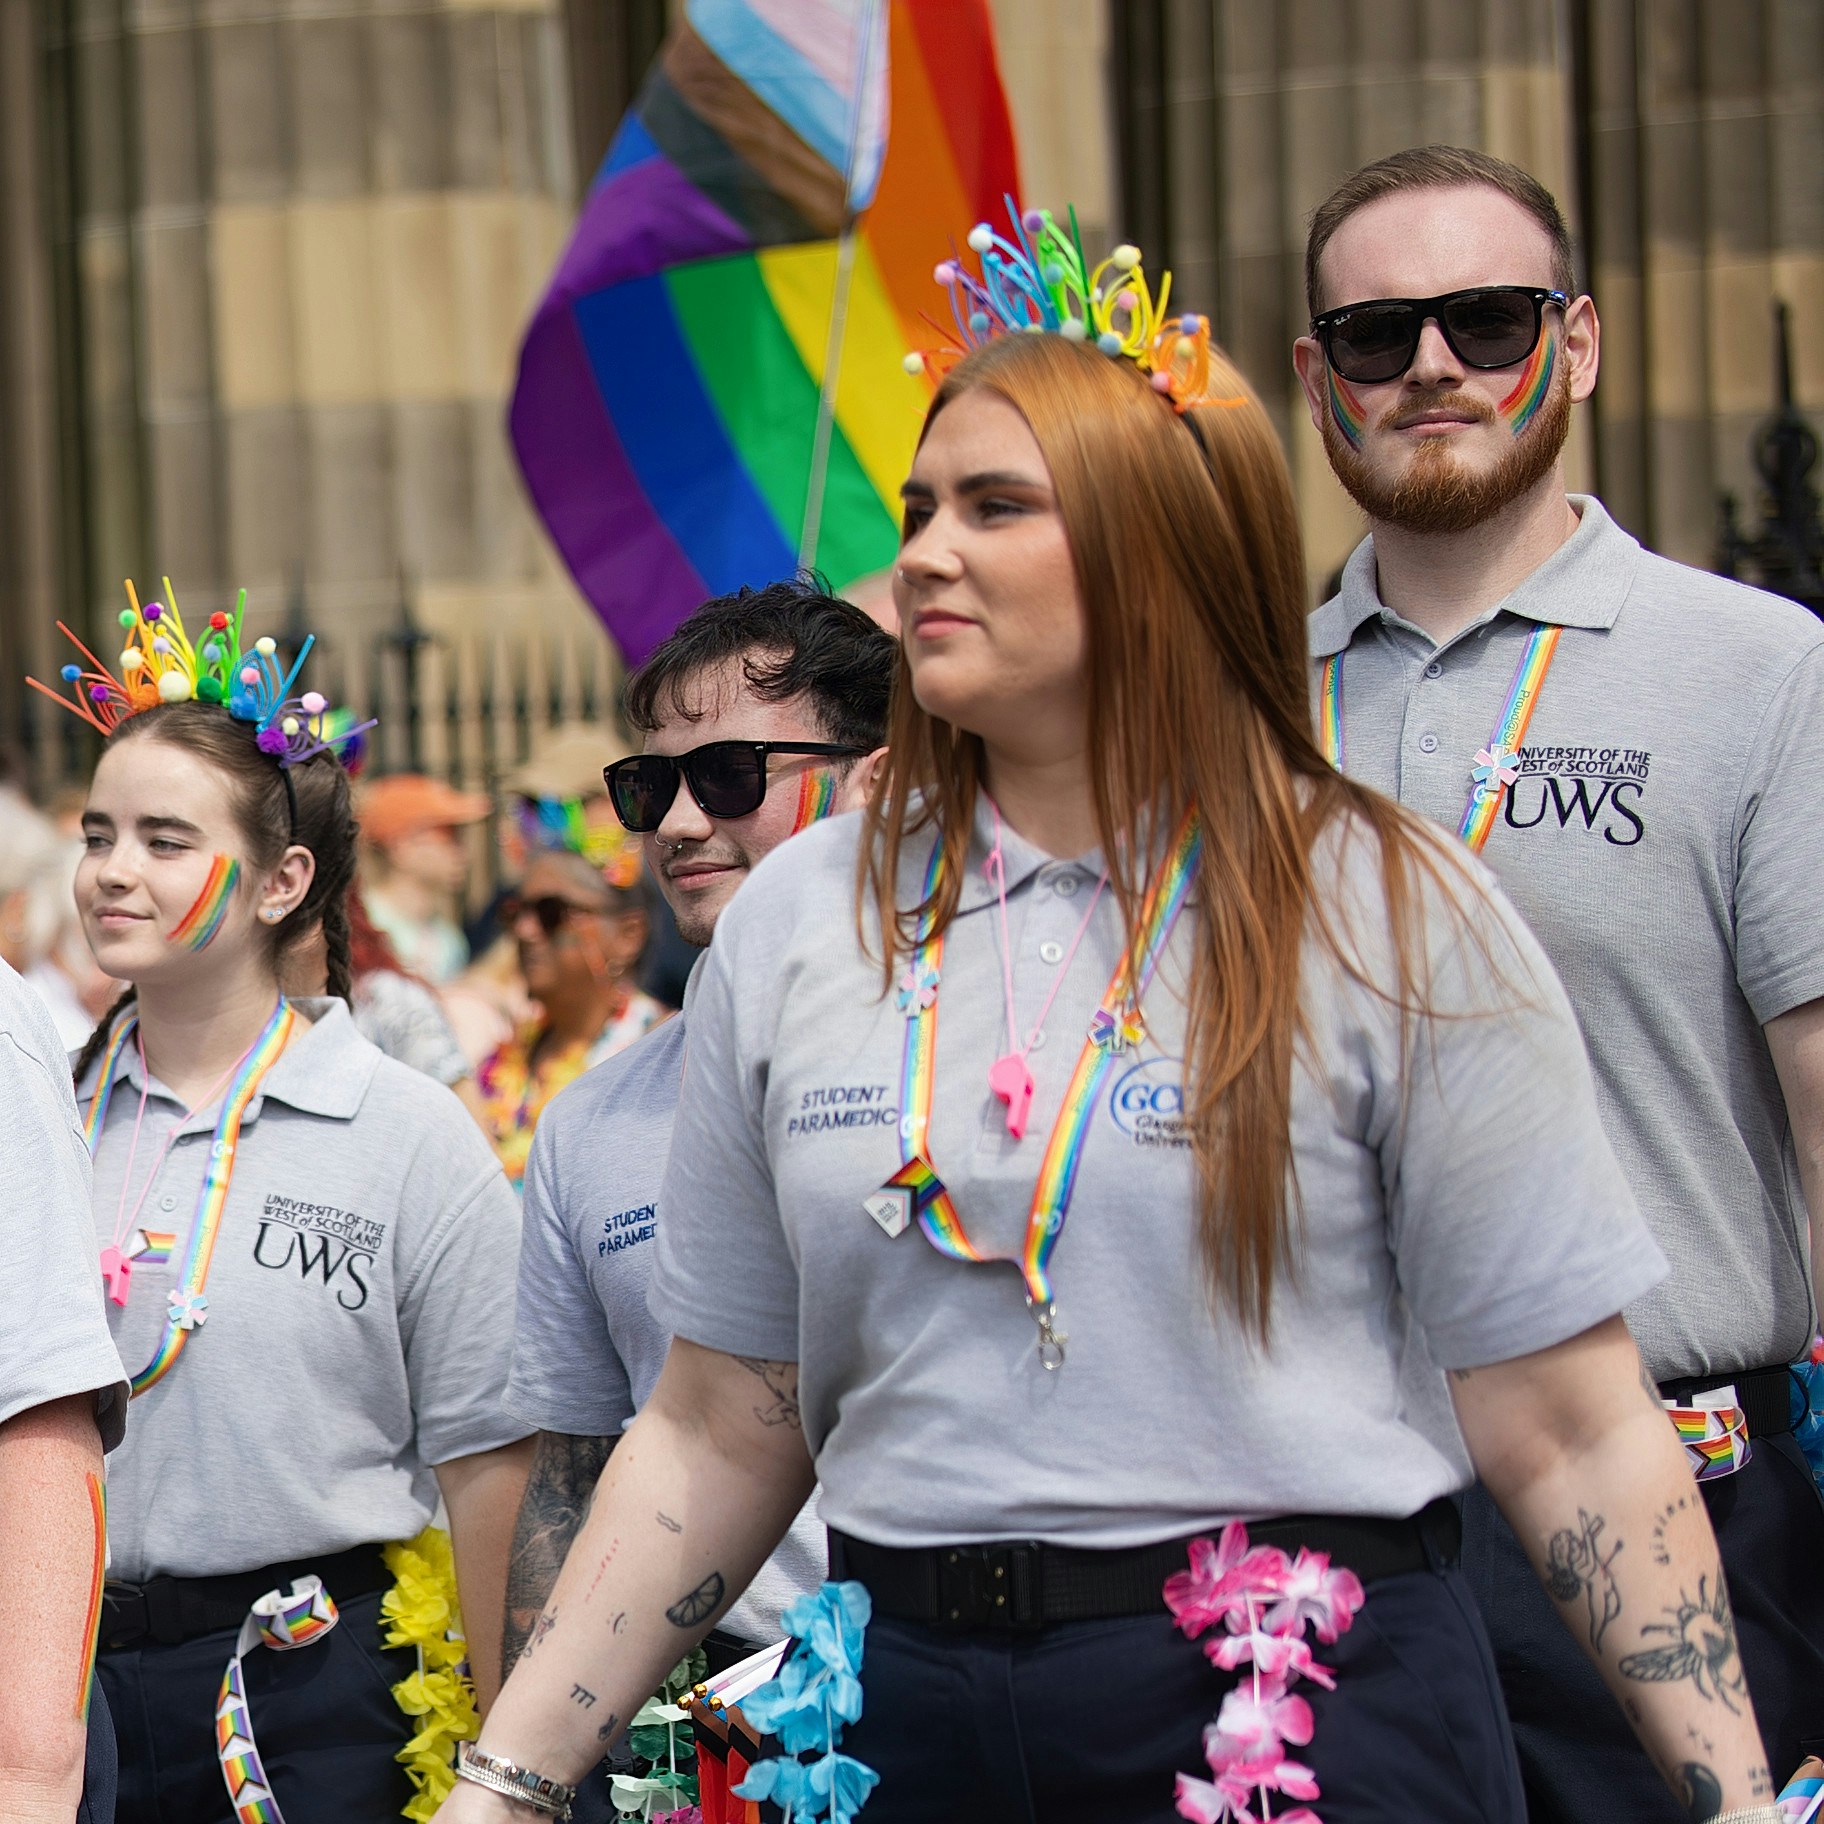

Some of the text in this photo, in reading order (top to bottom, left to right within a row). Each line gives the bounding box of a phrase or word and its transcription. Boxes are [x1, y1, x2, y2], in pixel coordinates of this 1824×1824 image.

[1548, 760, 1565, 774] of
[1565, 760, 1649, 779] SCOTLAND
[1599, 750, 1619, 762] OF
[1622, 750, 1652, 766] THE
[1504, 778, 1644, 846] UWS
[801, 1085, 889, 1110] STUDENT
[788, 1107, 899, 1138] PARAMEDIC
[266, 1193, 344, 1219] UNIVERSITY
[345, 1213, 363, 1226] OF
[604, 1203, 658, 1234] STUDEN
[263, 1205, 382, 1250] WEST of SCOTLAND
[598, 1222, 658, 1258] PARAME
[253, 1221, 375, 1311] UWS
